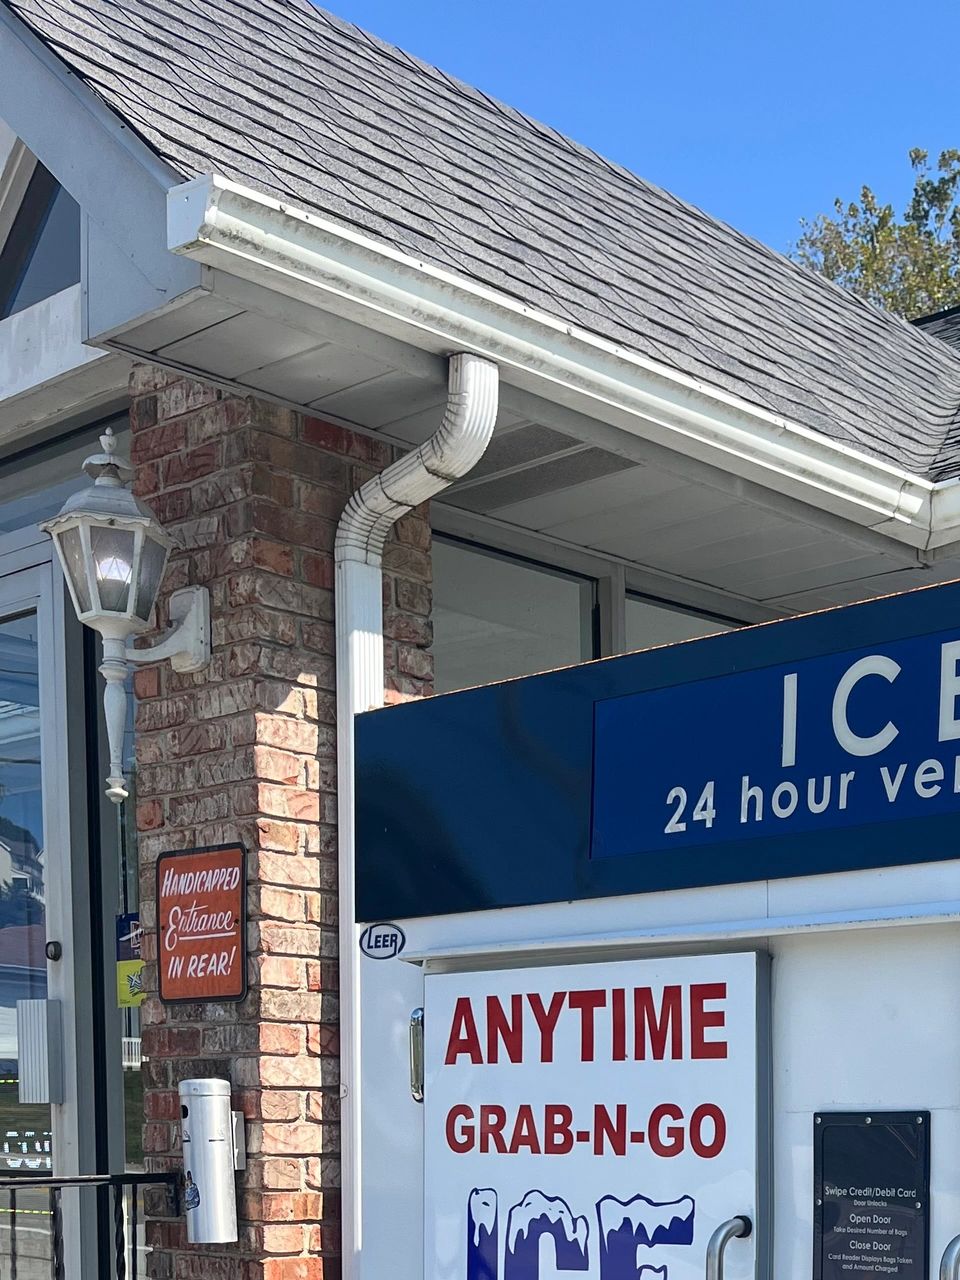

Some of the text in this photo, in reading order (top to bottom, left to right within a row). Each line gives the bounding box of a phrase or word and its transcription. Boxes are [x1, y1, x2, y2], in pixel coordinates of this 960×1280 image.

[664, 780, 716, 834] 24
[740, 771, 855, 823] hour
[162, 867, 240, 897] HANDICAPPED
[165, 900, 235, 950] Entrance
[366, 926, 398, 956] LEER
[168, 946, 236, 979] IN REAR!
[444, 982, 728, 1065] ANYTIME
[445, 1103, 727, 1158] GRAB-N-GO
[825, 1186, 916, 1198] Swipe Credit/Debit Card
[849, 1214, 891, 1224] Open Door
[895, 1229, 908, 1237] Bags
[849, 1240, 891, 1251] Close Door
[861, 1255, 882, 1263] Displays
[875, 1265, 898, 1273] Charged
